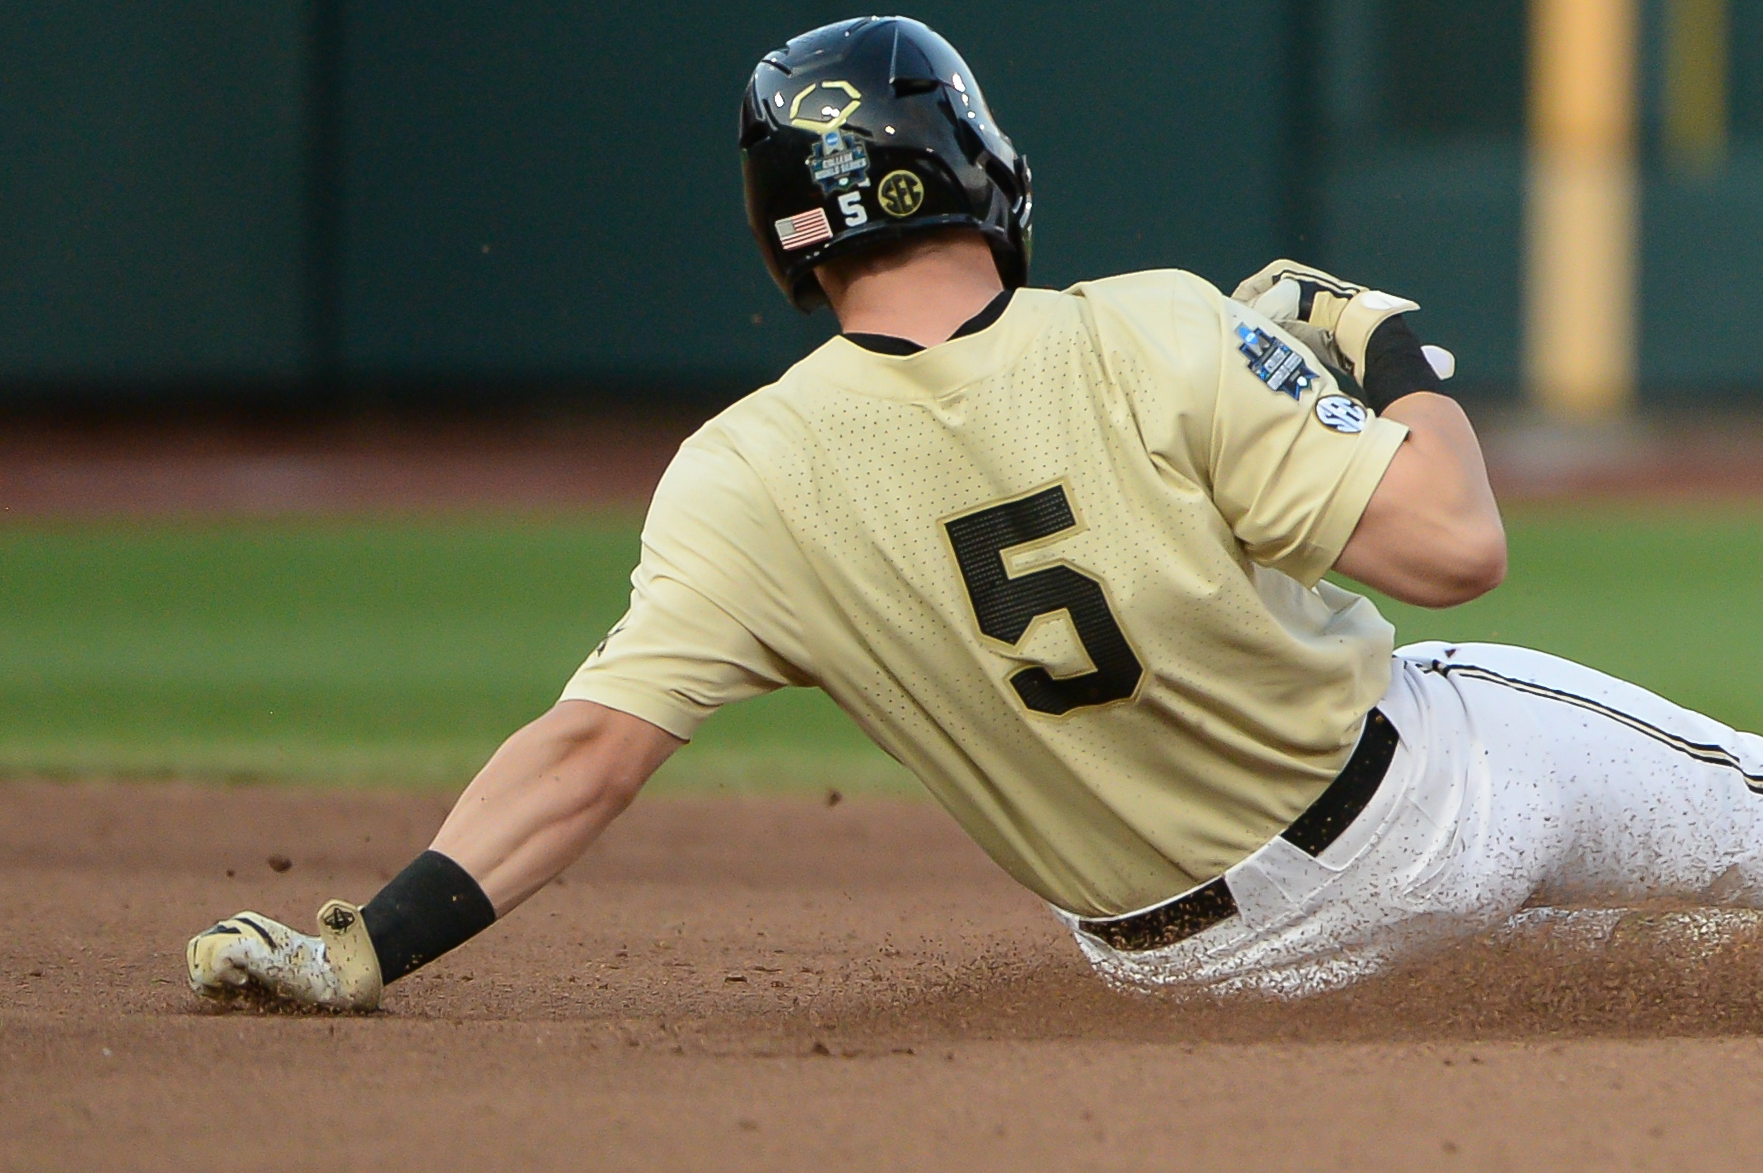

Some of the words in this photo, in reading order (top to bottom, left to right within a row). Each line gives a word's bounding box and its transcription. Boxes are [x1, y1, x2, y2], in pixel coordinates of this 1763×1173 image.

[837, 190, 868, 227] 5
[880, 173, 923, 213] SEC
[938, 477, 1146, 719] 5
